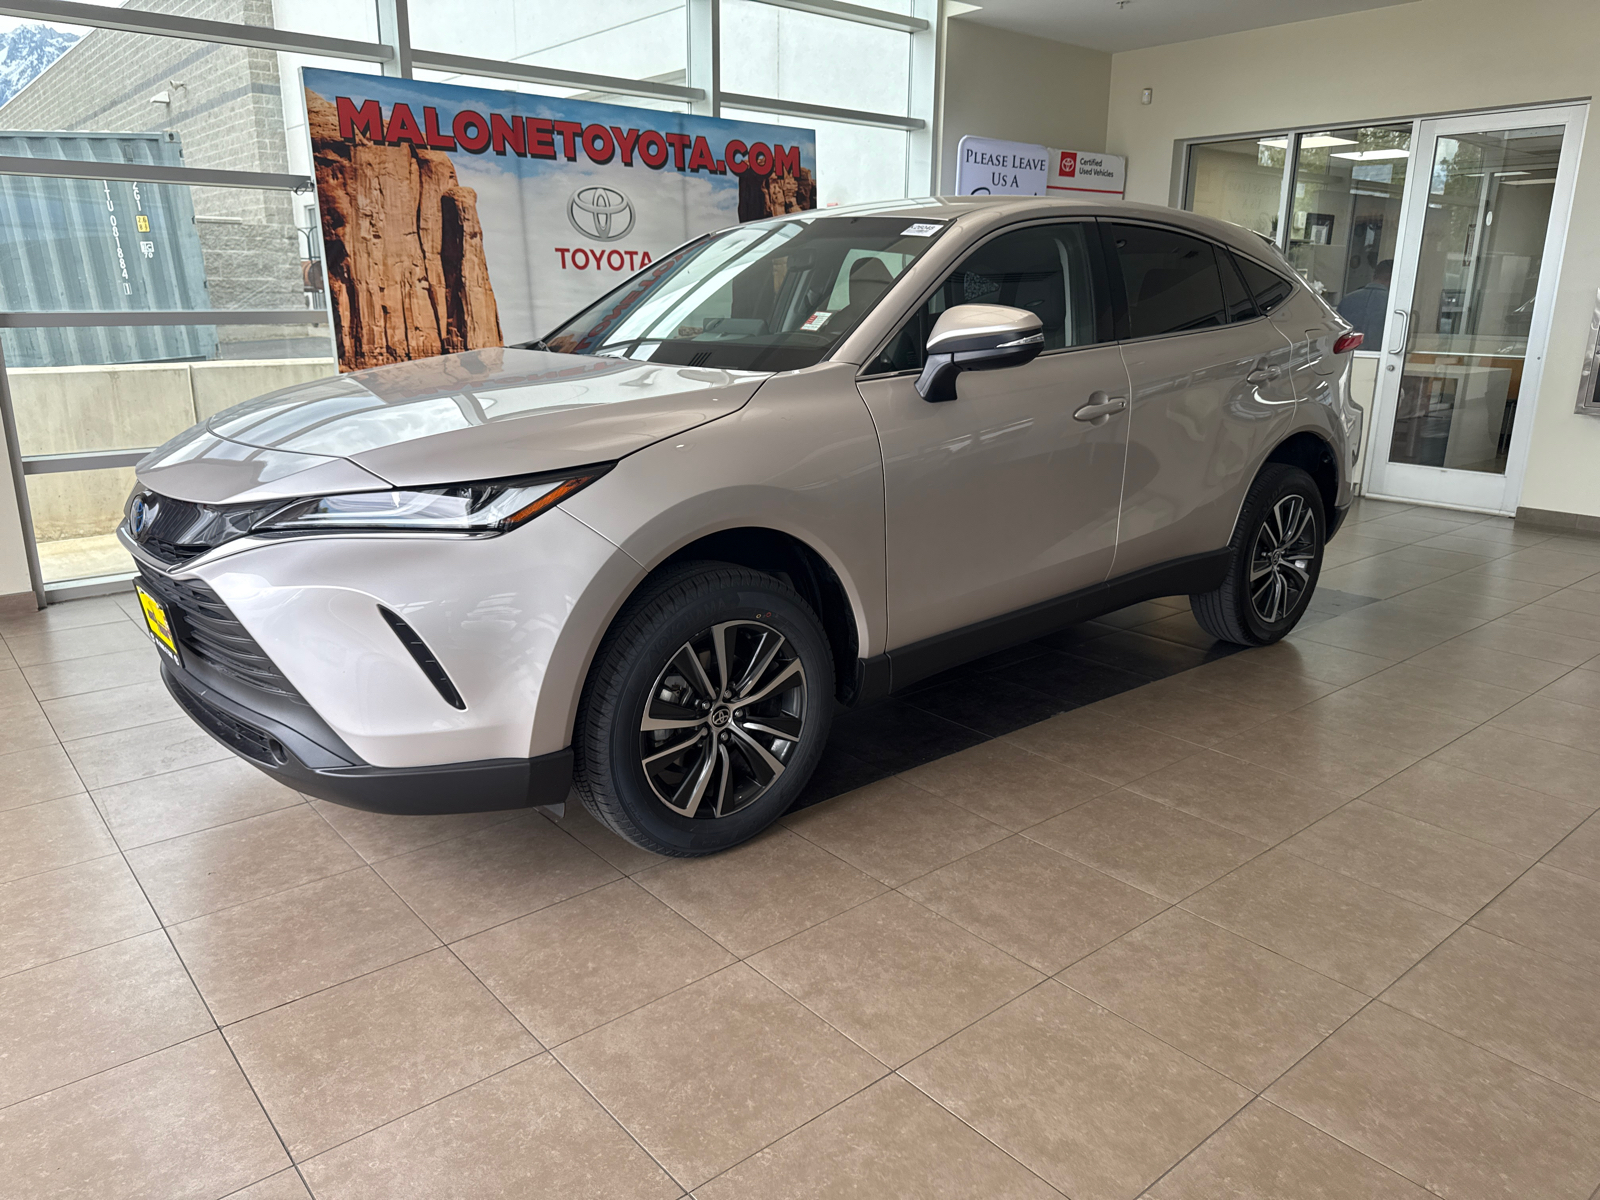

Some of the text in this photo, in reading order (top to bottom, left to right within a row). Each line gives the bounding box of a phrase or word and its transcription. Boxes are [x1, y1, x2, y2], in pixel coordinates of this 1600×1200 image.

[335, 96, 801, 178] MALONETOYOTA.COM
[965, 149, 1046, 172] PLEASE LEAVE
[1079, 157, 1103, 168] Certified
[991, 171, 1020, 188] US A
[1078, 167, 1114, 178] Used Vehicles
[554, 247, 652, 272] TOYOTA
